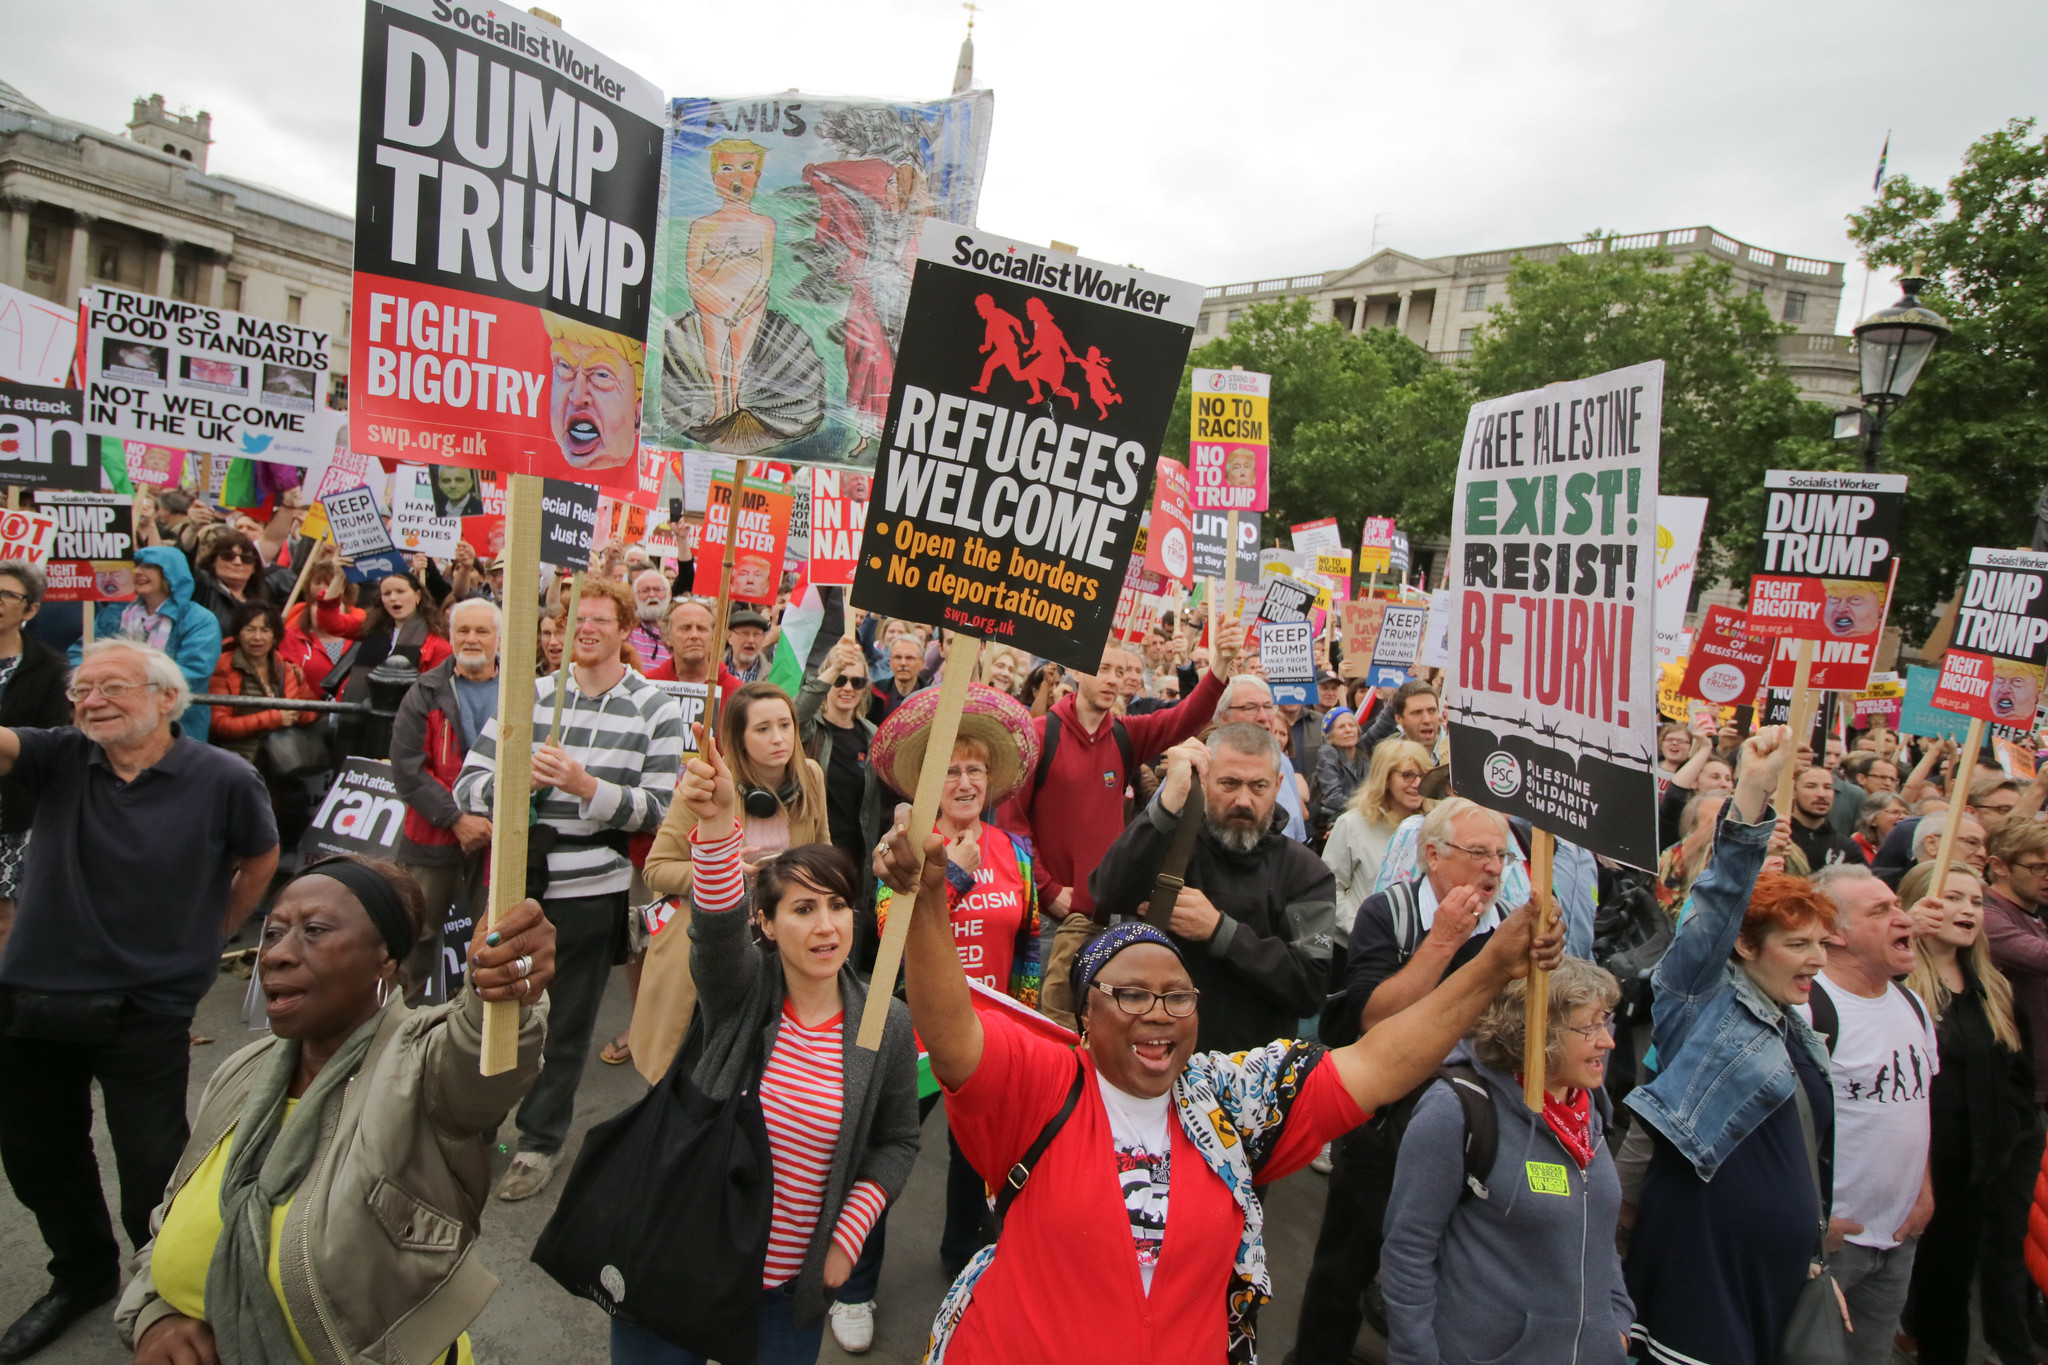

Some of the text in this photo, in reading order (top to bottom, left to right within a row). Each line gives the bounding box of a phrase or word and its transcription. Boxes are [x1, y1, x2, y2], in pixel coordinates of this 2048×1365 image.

[552, 40, 626, 102] Worker
[384, 25, 619, 206] DUMP
[672, 101, 806, 137] ANUS
[376, 144, 646, 320] TRUMP
[952, 235, 1170, 315] Socialist Worker
[97, 289, 328, 350] TRUMP'S NASTY
[369, 292, 497, 360] FIGHT
[91, 310, 328, 371] FOOD STANDARDS
[368, 346, 545, 418] BIGOTRY
[1229, 383, 1238, 391] TO
[13, 397, 72, 415] attack
[89, 382, 149, 409] NOT
[163, 394, 305, 433] WELCOME
[1197, 397, 1253, 419] NO TO
[90, 403, 235, 443] IN THE UK
[1197, 418, 1262, 440] RACISM
[1468, 385, 1643, 470] FREE PALESTINE
[0, 414, 88, 467] an
[126, 442, 146, 457] NO
[368, 424, 487, 458] swp.org.uk
[894, 384, 1146, 506] REFUGEES
[125, 454, 142, 468] TO
[1196, 445, 1225, 467] NO
[1195, 466, 1222, 487] TO
[1788, 476, 1880, 490] Socialist Worker
[328, 496, 370, 517] KEEP
[405, 501, 435, 512] HAN
[542, 497, 571, 518] ecial
[714, 485, 769, 513] TRMP:
[1195, 487, 1257, 508] TRUMP
[1465, 467, 1641, 536] EXIST!
[334, 512, 375, 530] TRUMP
[814, 498, 842, 529] IN
[884, 450, 1127, 570] WELCOME
[1765, 492, 1875, 536] DUMP
[398, 515, 457, 528] OFF OUR
[1193, 513, 1257, 549] ump
[1366, 519, 1389, 529] STAND
[341, 536, 384, 550] OUR NHS
[401, 527, 451, 540] BODIES
[550, 523, 577, 546] Just
[48, 531, 131, 559] RUMP
[813, 530, 864, 560] NA
[1762, 532, 1890, 577] TRUMP
[895, 520, 1100, 602] Open the borders
[1129, 553, 1145, 566] NO
[1204, 555, 1222, 568] Say
[1318, 556, 1341, 566] NO TO
[1318, 563, 1346, 575] RACISM
[1127, 565, 1141, 578] TO
[1464, 543, 1638, 601] RESIST!
[887, 554, 1075, 631] No deportations
[1123, 576, 1159, 593] TRUMP
[1267, 580, 1307, 610] DUMP
[1754, 580, 1802, 600] FIGHT
[1963, 569, 2043, 614] DUMP
[1262, 600, 1305, 623] TRUMP
[1715, 614, 1731, 626] WE
[1752, 598, 1821, 620] BIGOTRY
[944, 605, 1015, 636] swp.org.uk
[1386, 613, 1421, 628] KEEP
[1264, 628, 1308, 643] KEEP
[1384, 628, 1418, 640] TRUMP
[1956, 607, 2048, 659] TRUMP
[1264, 644, 1307, 656] TRUMP
[1378, 648, 1414, 659] OUR NHS
[1703, 643, 1764, 665] RESISTANCE
[1730, 639, 1745, 650] OF
[1264, 665, 1308, 674] OUR NHS
[1460, 590, 1635, 729] RETURN!
[1945, 654, 1983, 677] FIGHT
[1706, 678, 1738, 692] TRUMP
[1712, 671, 1738, 682] STOP
[1940, 671, 1990, 698] BIGOTRY
[345, 769, 397, 794] Don't attac
[1491, 764, 1514, 785] PSC
[312, 772, 406, 848] Iran
[955, 890, 1017, 912] ACISM
[956, 945, 984, 963] ED
[1529, 1163, 1563, 1174] BOLLOCKS
[1542, 1170, 1563, 1178] BREXIT
